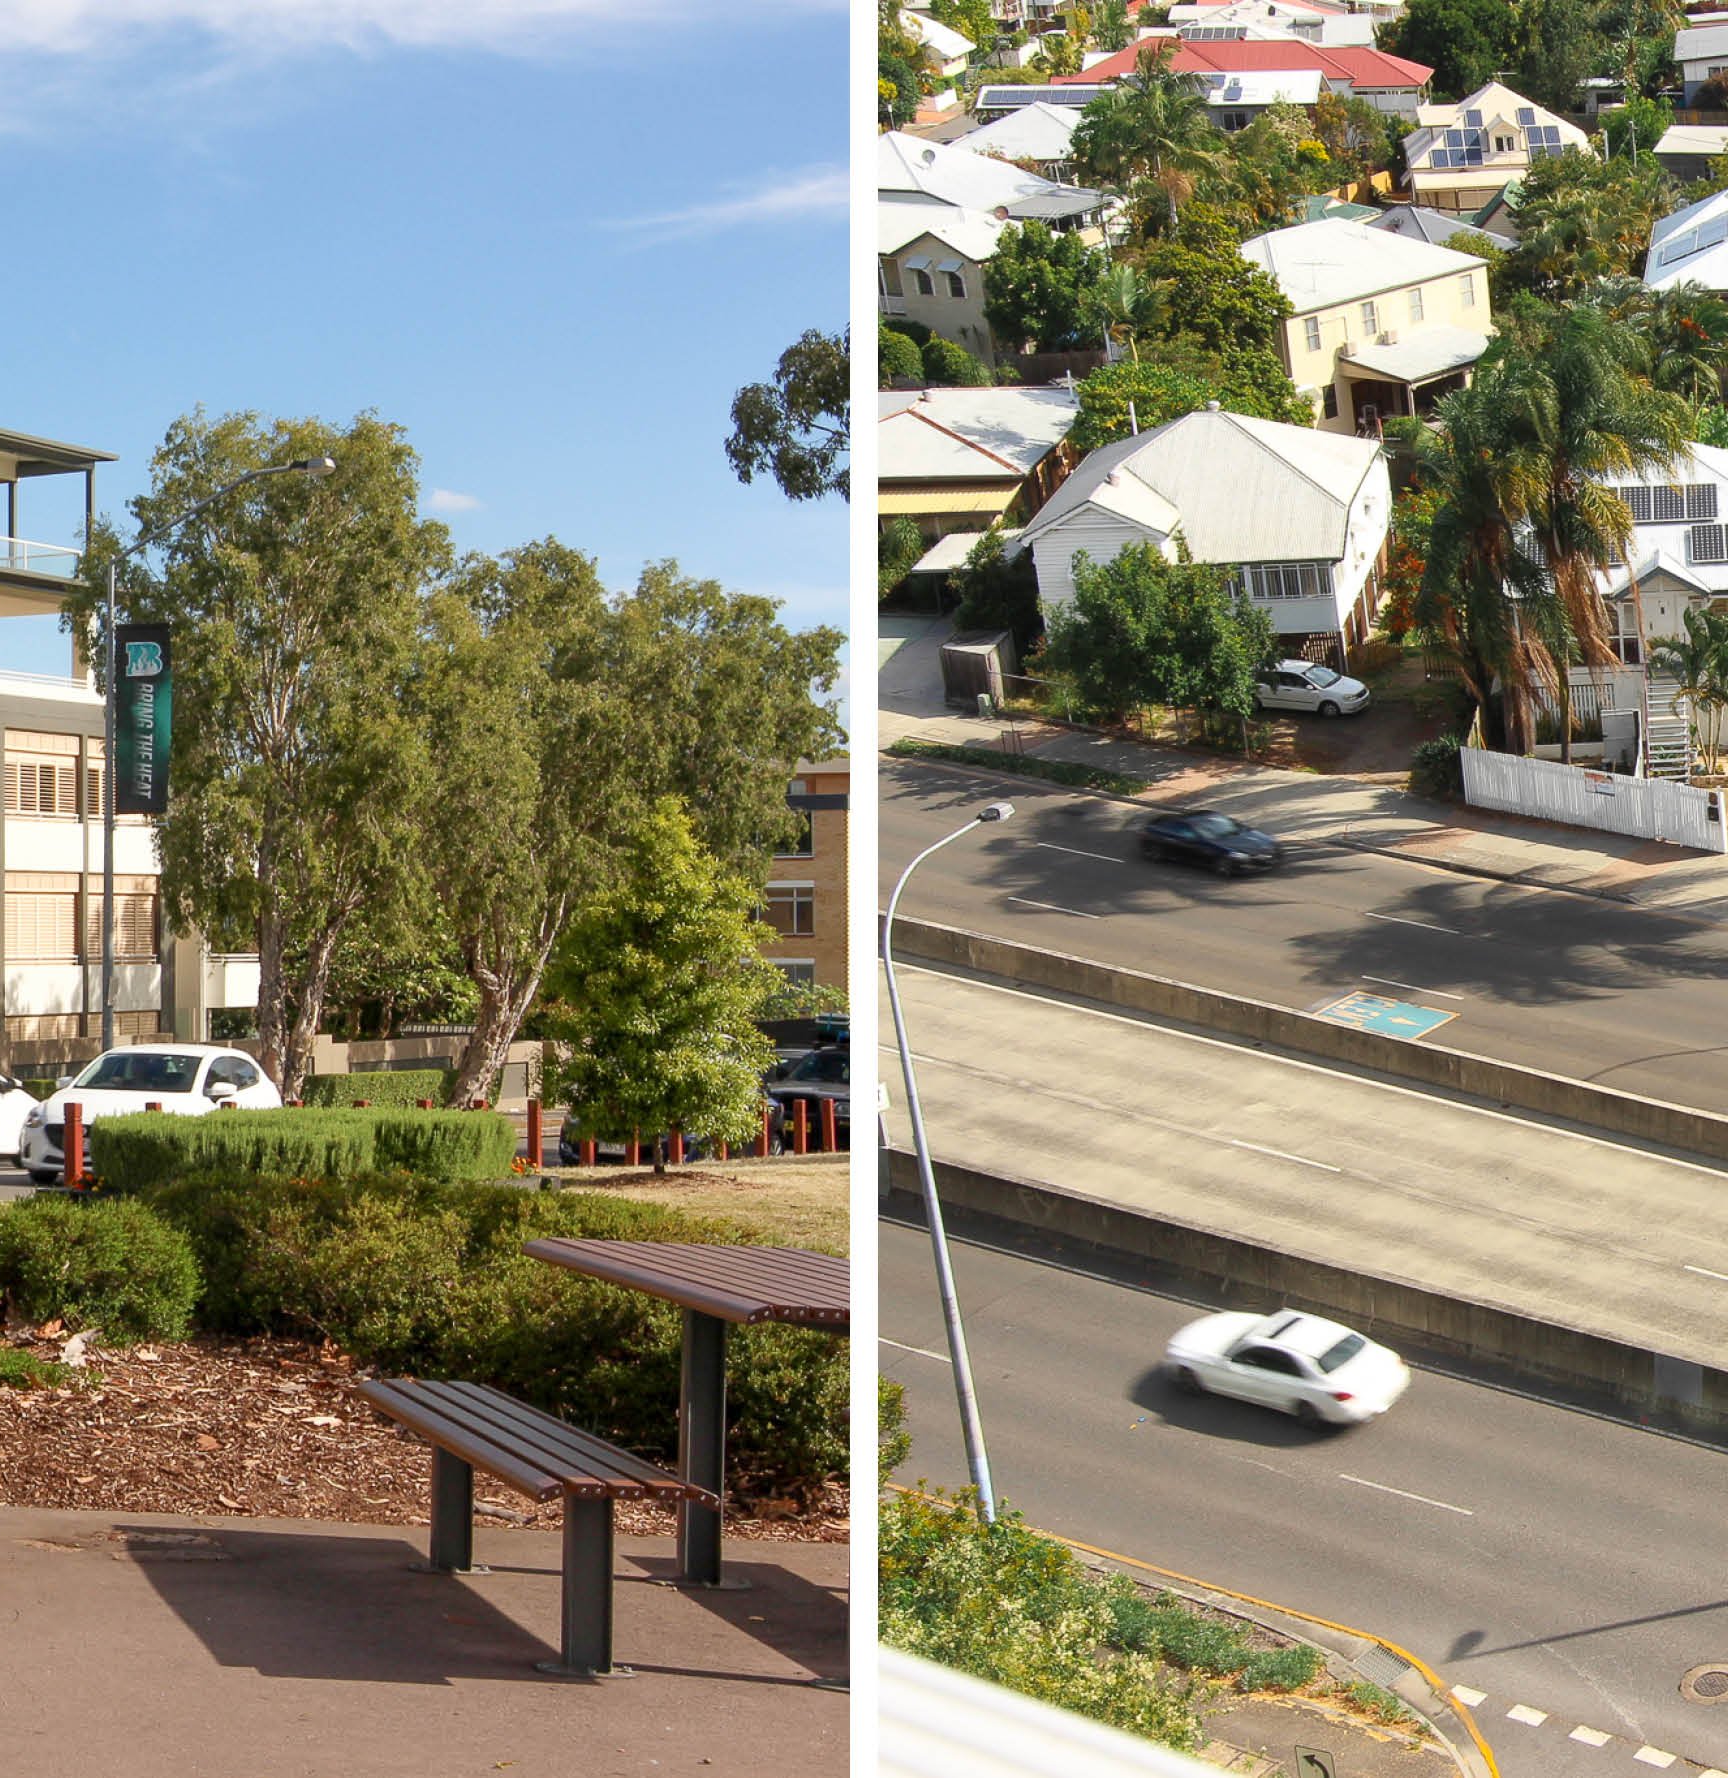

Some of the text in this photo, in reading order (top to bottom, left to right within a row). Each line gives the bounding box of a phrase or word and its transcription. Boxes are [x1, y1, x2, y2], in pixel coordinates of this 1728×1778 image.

[133, 683, 154, 799] BRING THE HEAT
